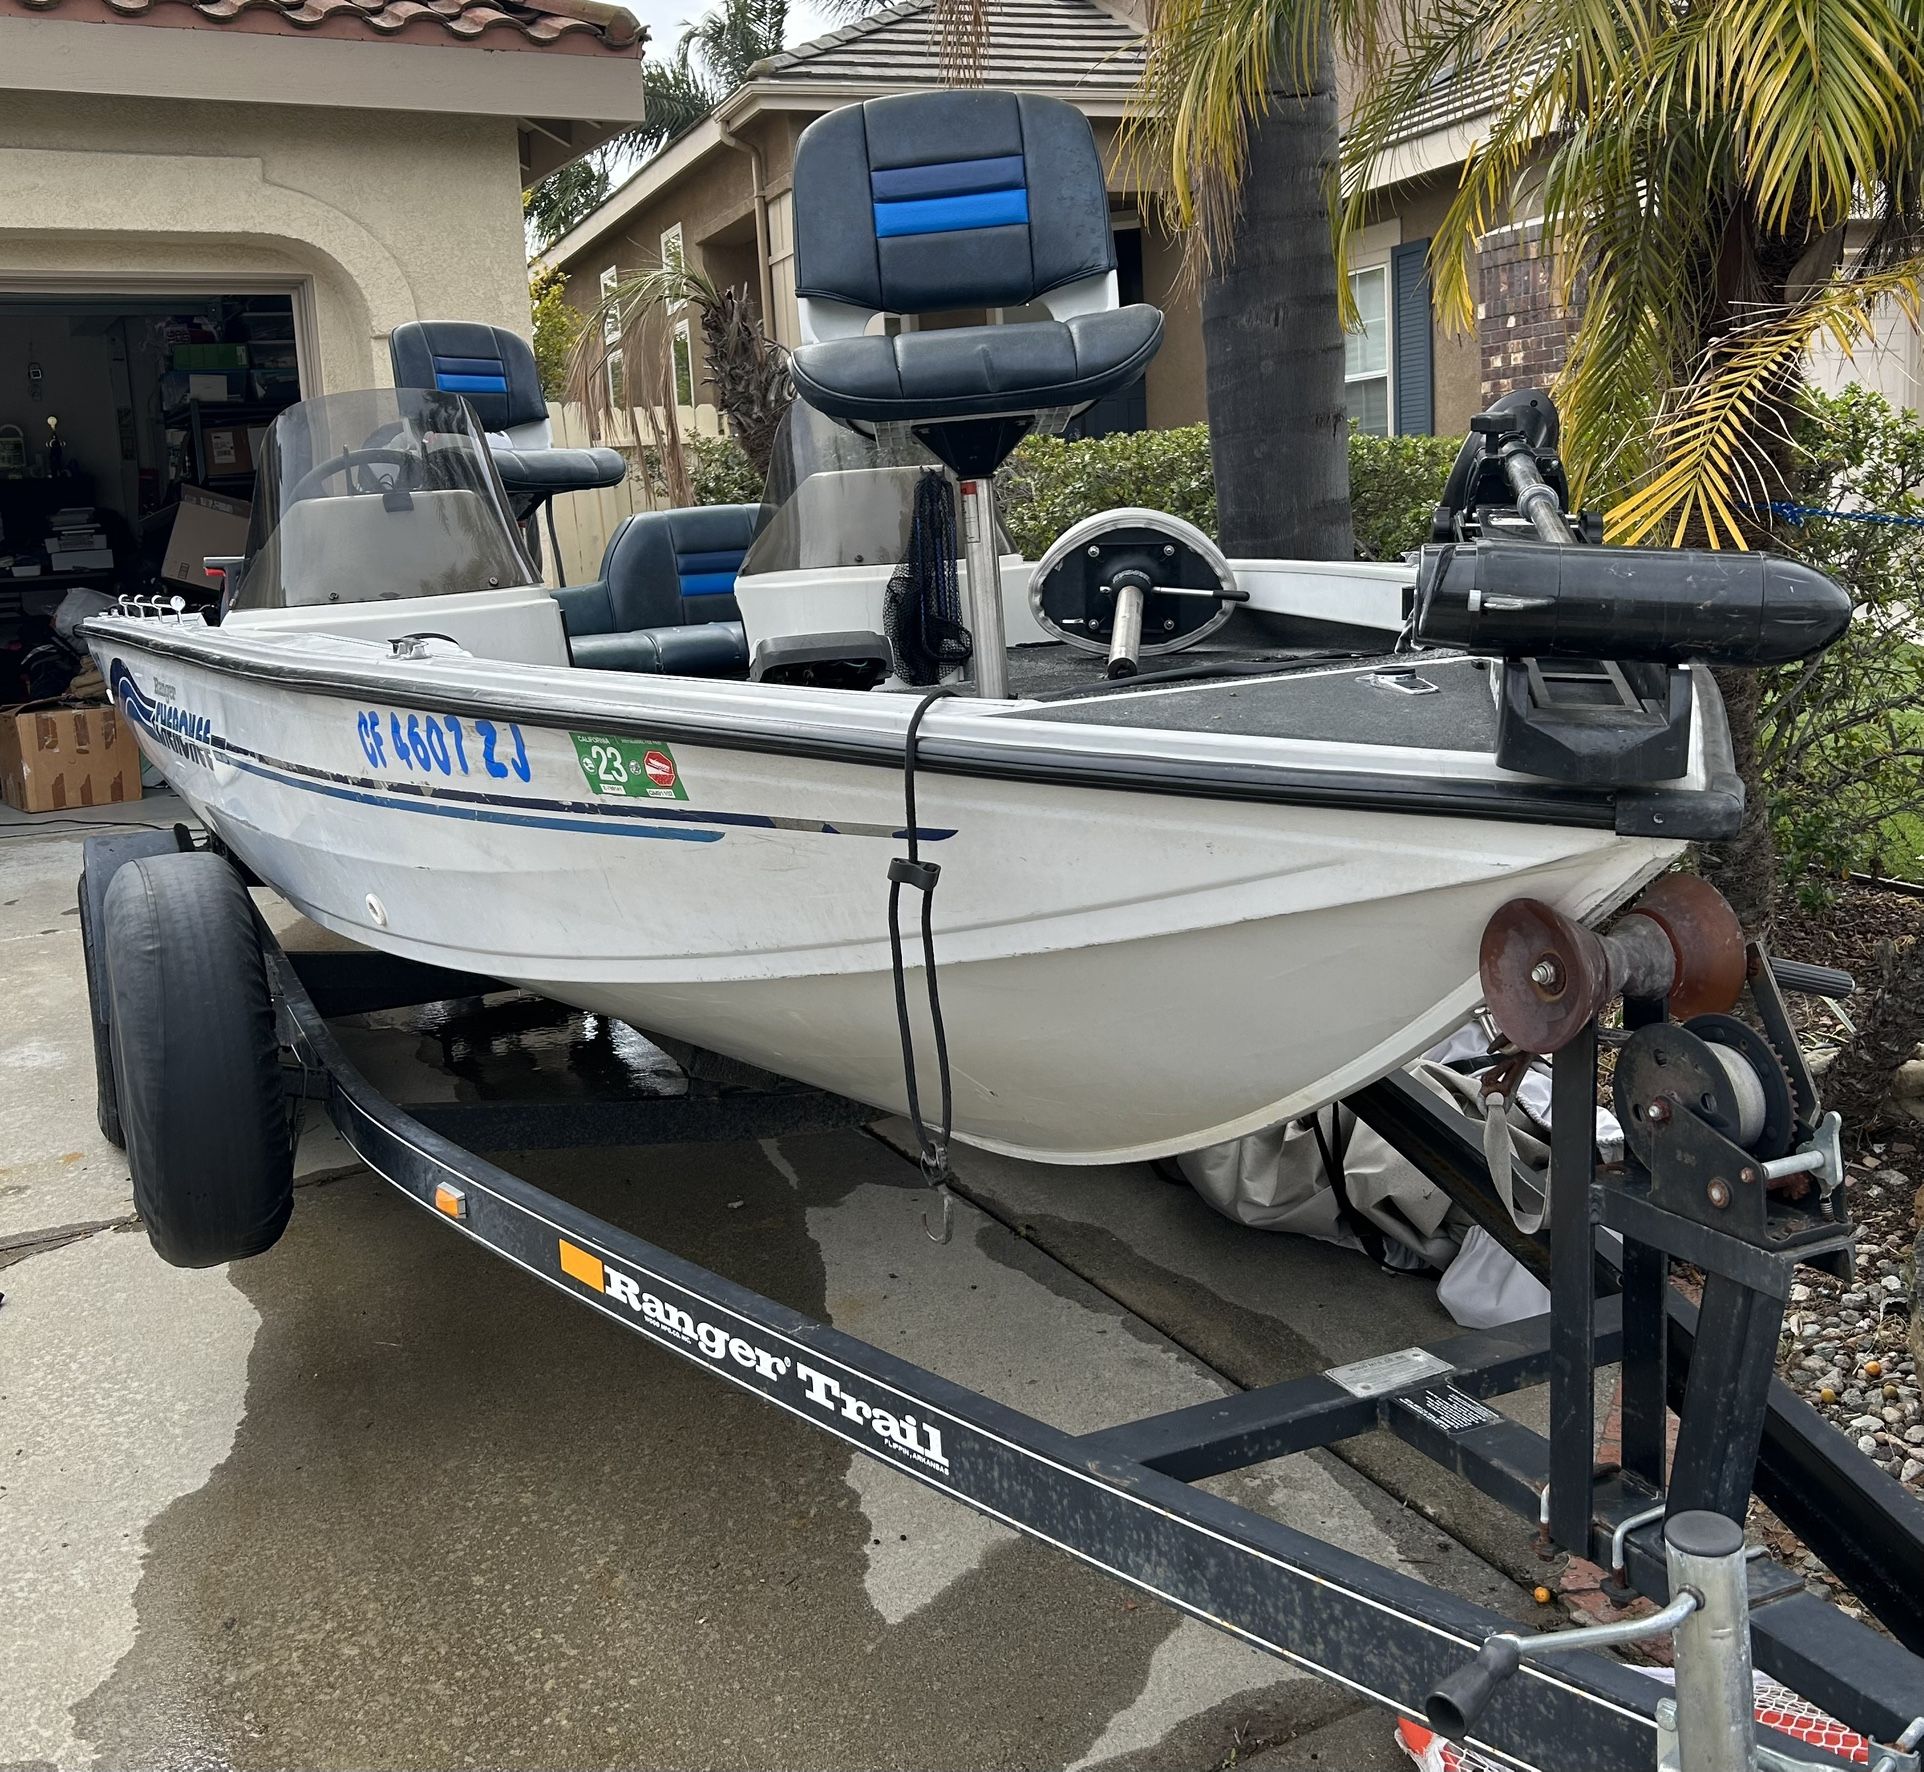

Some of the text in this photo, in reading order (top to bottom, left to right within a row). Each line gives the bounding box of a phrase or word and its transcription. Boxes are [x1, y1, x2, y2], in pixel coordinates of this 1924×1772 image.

[153, 676, 177, 704] Ranger
[358, 711, 387, 769] CF
[577, 735, 611, 745] CALIFORNIA
[591, 745, 628, 783] 23
[797, 1361, 950, 1468] Trail
